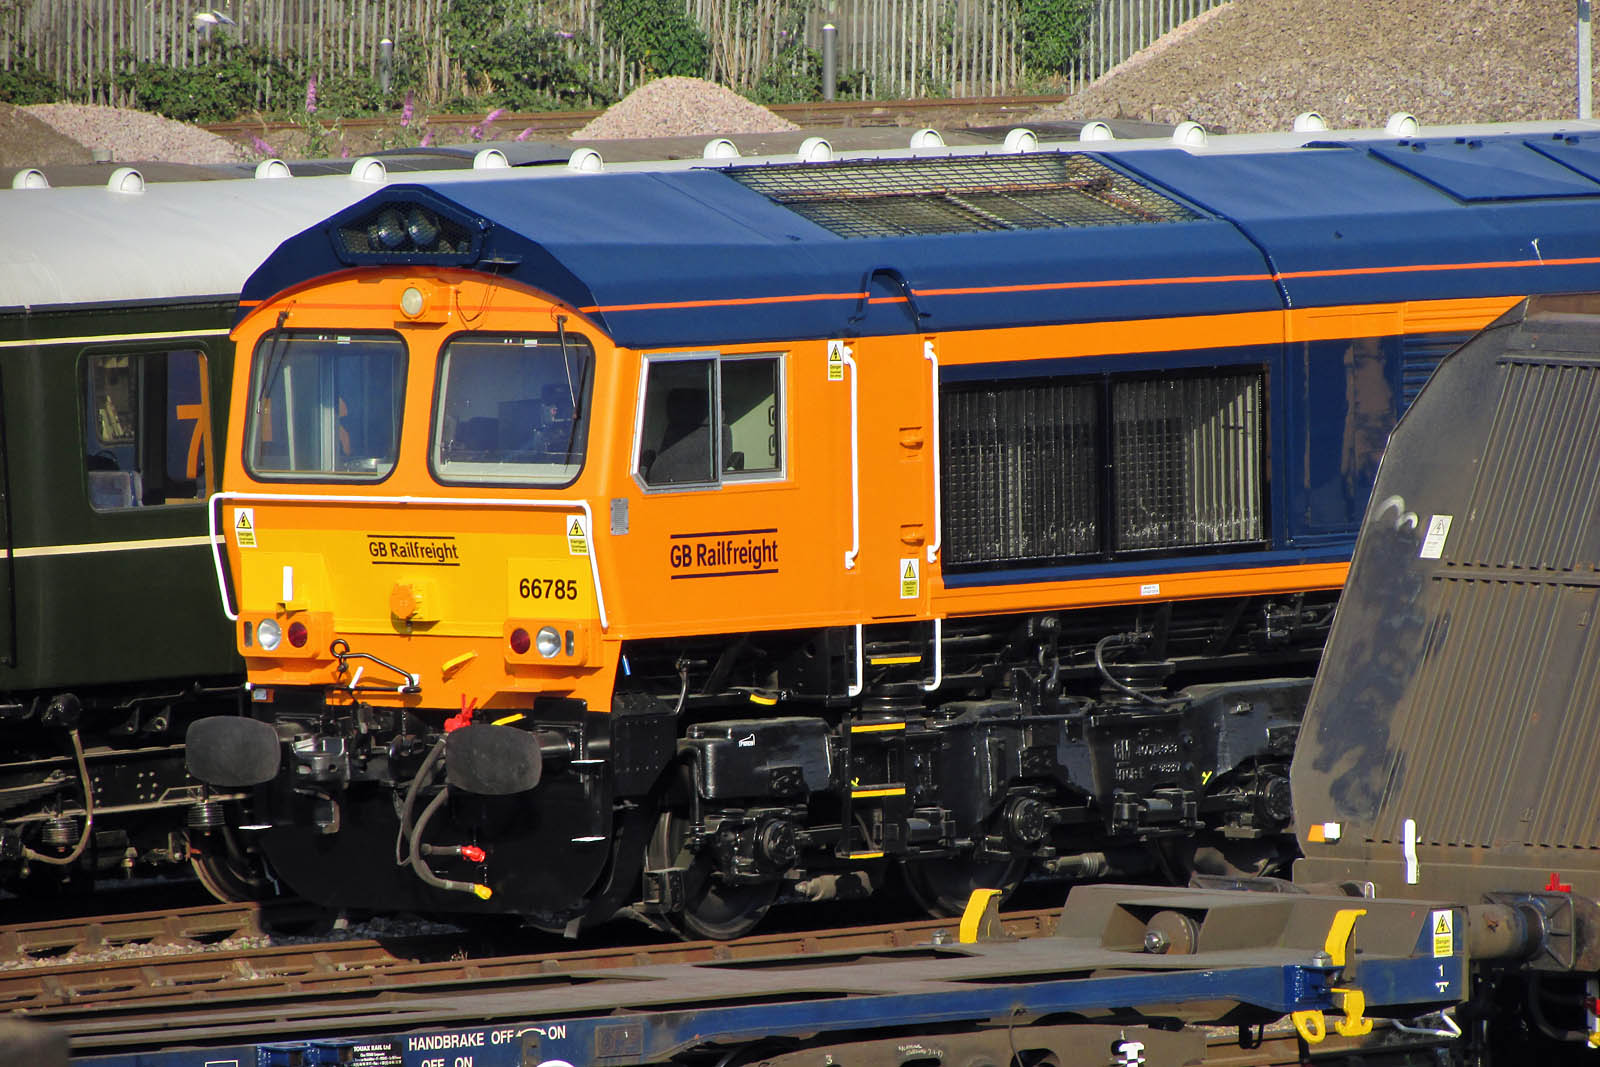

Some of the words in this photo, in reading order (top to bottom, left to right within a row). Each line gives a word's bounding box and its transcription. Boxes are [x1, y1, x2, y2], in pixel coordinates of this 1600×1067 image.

[369, 541, 388, 557] GB
[389, 541, 459, 563] Railfreight
[670, 544, 692, 568] GB
[696, 538, 779, 569] Railfreight
[519, 577, 578, 600] 66785
[408, 1032, 485, 1051] HANDBRAKE
[490, 1030, 515, 1045] OFF
[547, 1025, 567, 1040] ON
[421, 1058, 446, 1067] OFF
[454, 1056, 473, 1067] ON
